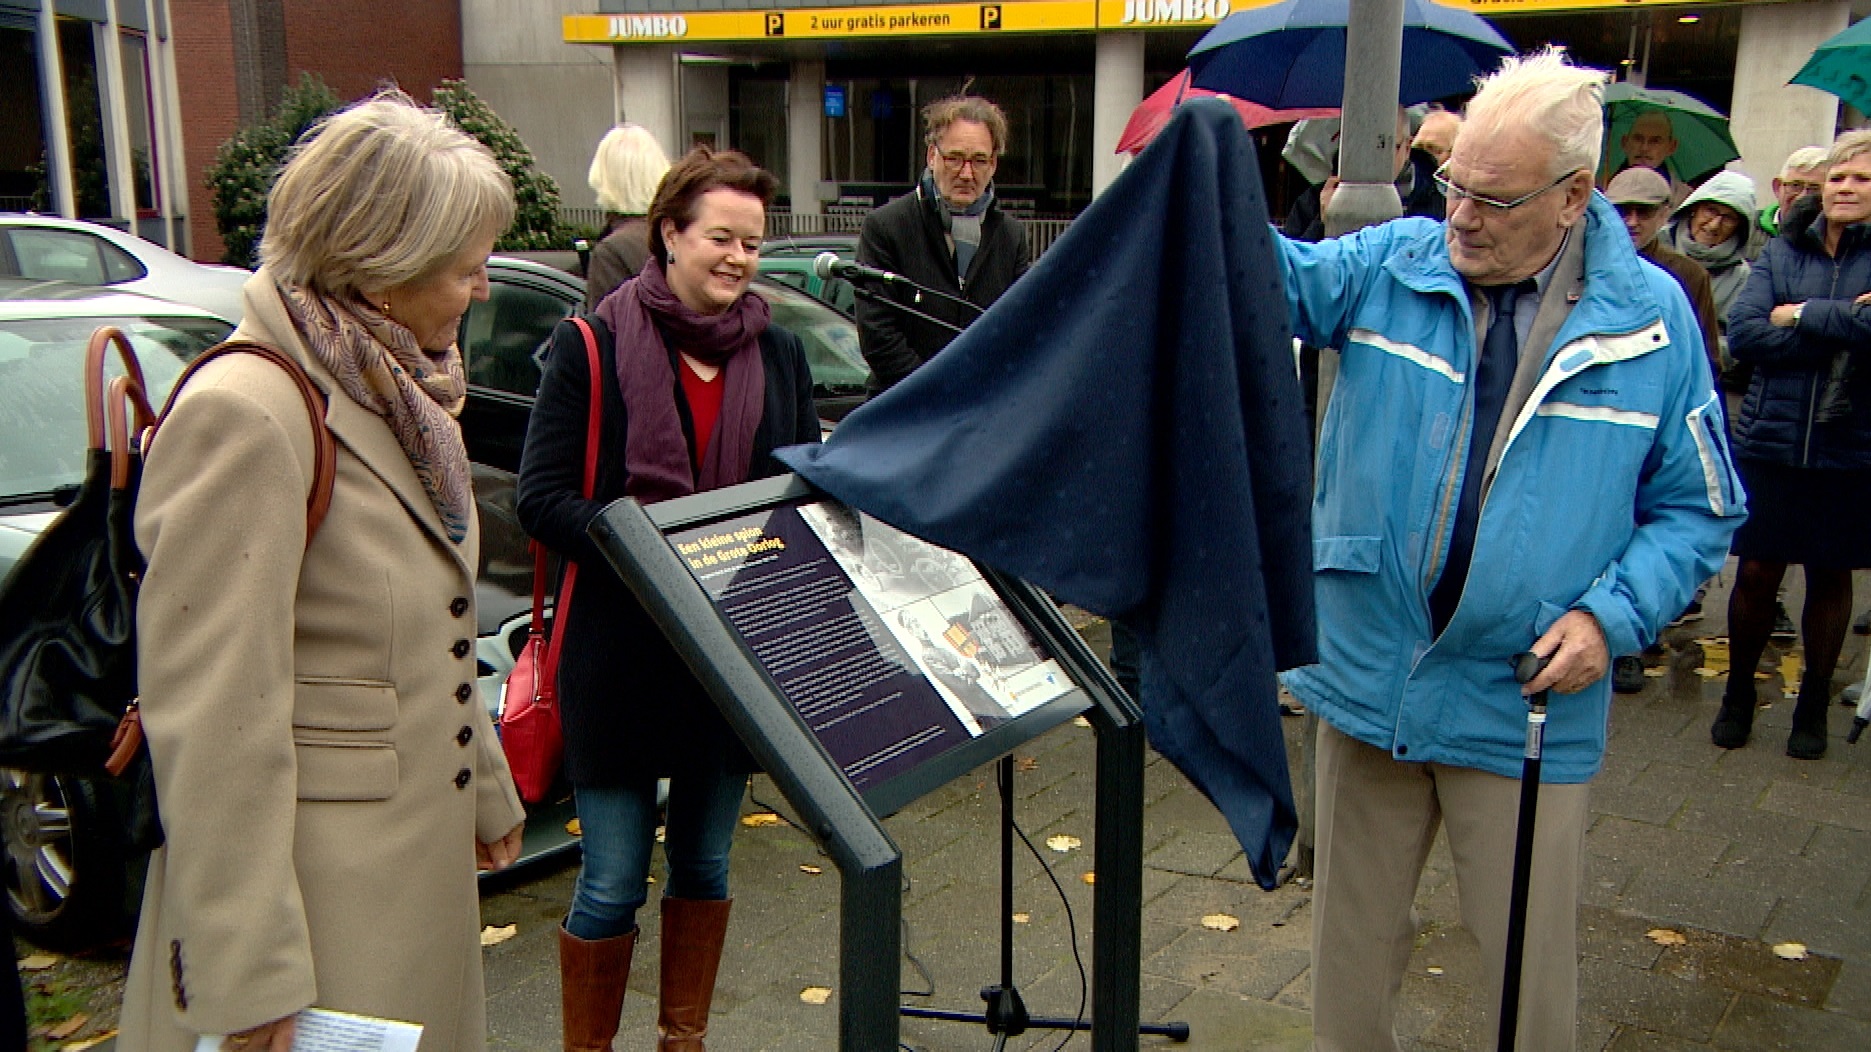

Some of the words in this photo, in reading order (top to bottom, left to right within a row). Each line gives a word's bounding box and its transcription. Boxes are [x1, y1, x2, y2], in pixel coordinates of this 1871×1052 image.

[810, 15, 818, 30] 2
[822, 17, 843, 29] uur
[847, 13, 885, 30] gratis
[889, 11, 950, 30] parkeren
[983, 7, 998, 28] P
[1121, 0, 1230, 24] JUMBO
[608, 14, 688, 38] JUMBO
[768, 15, 782, 36] P
[698, 534, 734, 549] kleine
[716, 546, 749, 562] Grote
